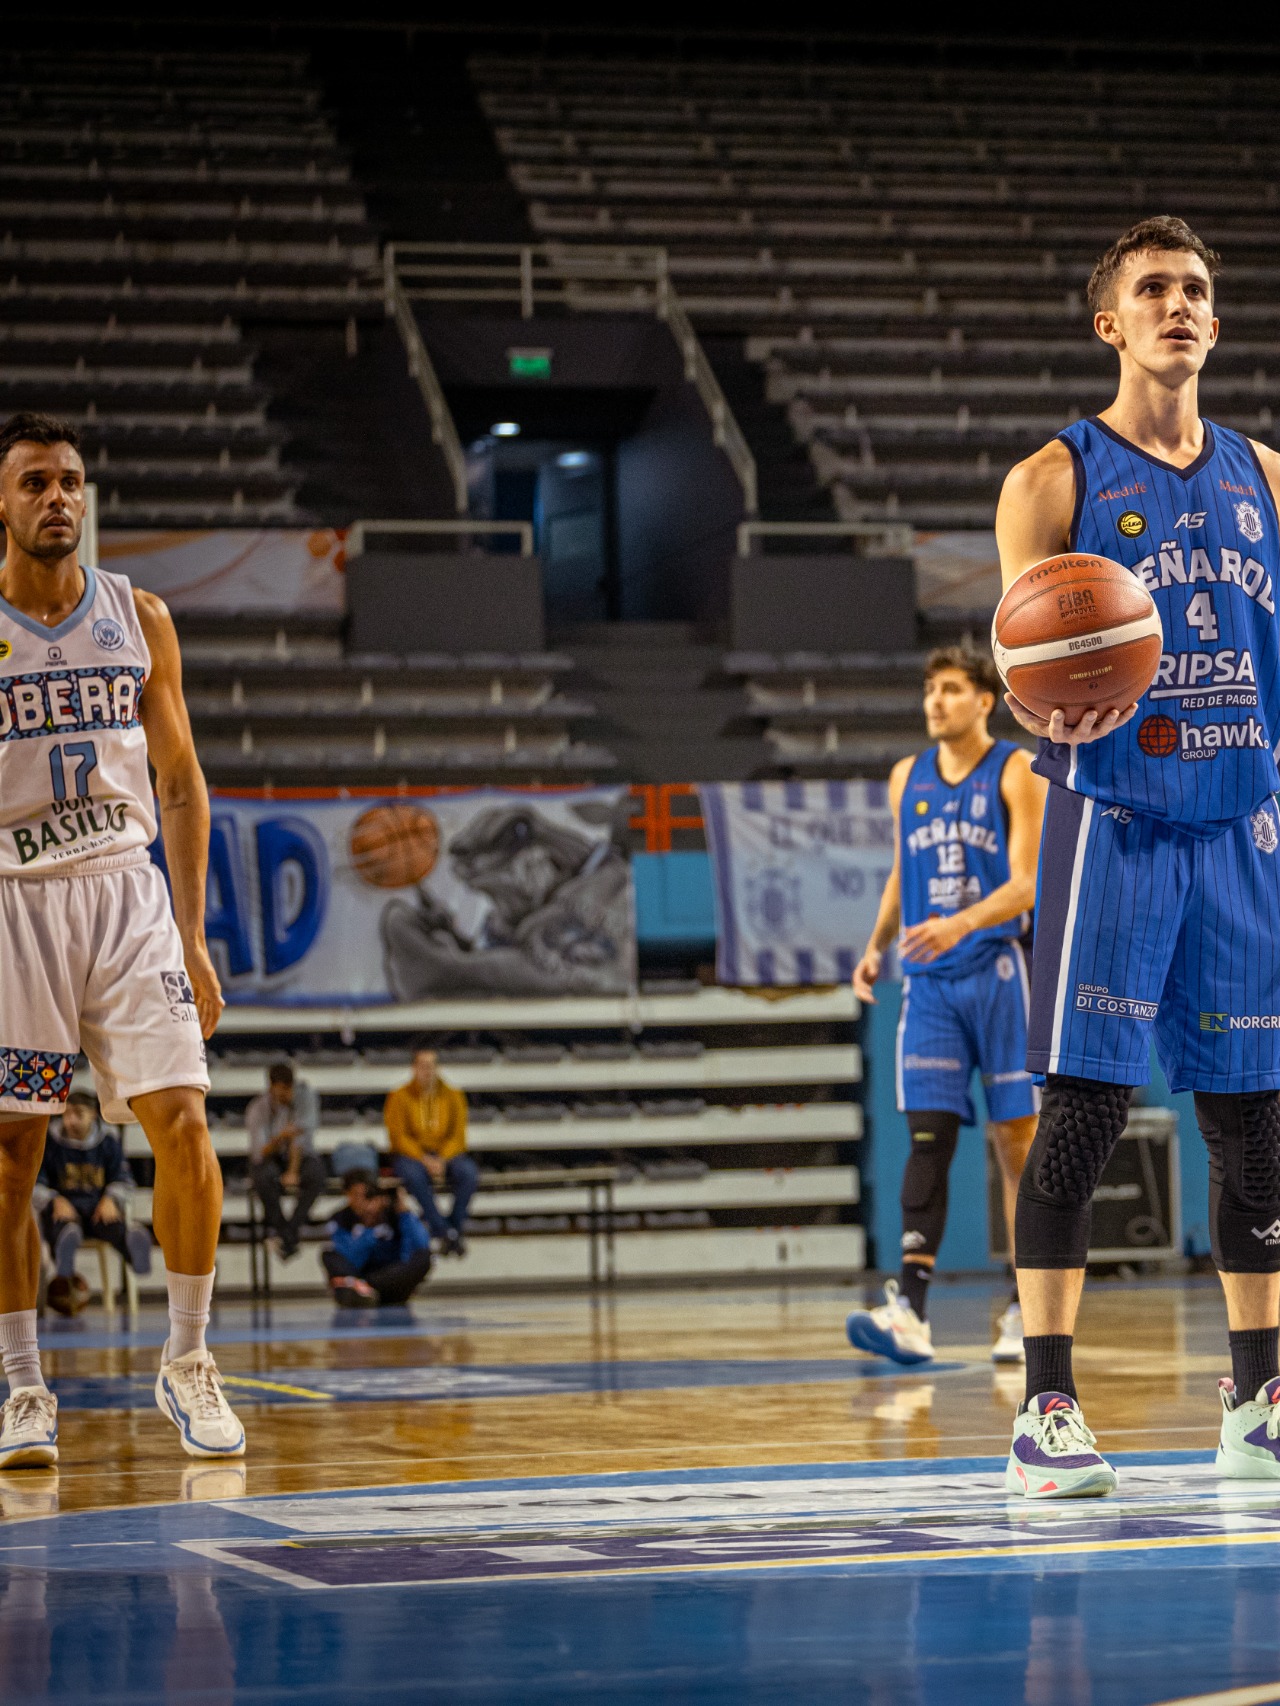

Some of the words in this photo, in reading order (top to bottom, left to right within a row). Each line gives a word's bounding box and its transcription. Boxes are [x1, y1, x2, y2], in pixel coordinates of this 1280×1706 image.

[1098, 482, 1147, 501] Medifé
[1029, 559, 1102, 583] molten
[1132, 541, 1275, 615] EÑAROL
[1058, 589, 1095, 610] FIBA
[1060, 605, 1097, 619] APPROVED
[1186, 592, 1218, 640] 4
[1068, 636, 1103, 651] BG4500
[1069, 665, 1113, 680] COMPETITION
[1152, 651, 1256, 686] RIPSA
[1182, 697, 1205, 709] RED
[1208, 695, 1223, 706] DE
[1226, 694, 1257, 706] PAGOS
[1182, 749, 1217, 760] GROUP
[49, 741, 98, 801] 17
[12, 803, 128, 865] BASILIO
[51, 845, 88, 860] YERBA
[937, 843, 965, 875] 12
[204, 814, 329, 978] AD
[1078, 983, 1109, 994] GRUPO
[1076, 996, 1092, 1009] DI
[1097, 999, 1158, 1018] COSTANZO
[375, 1493, 764, 1512] MDQ
